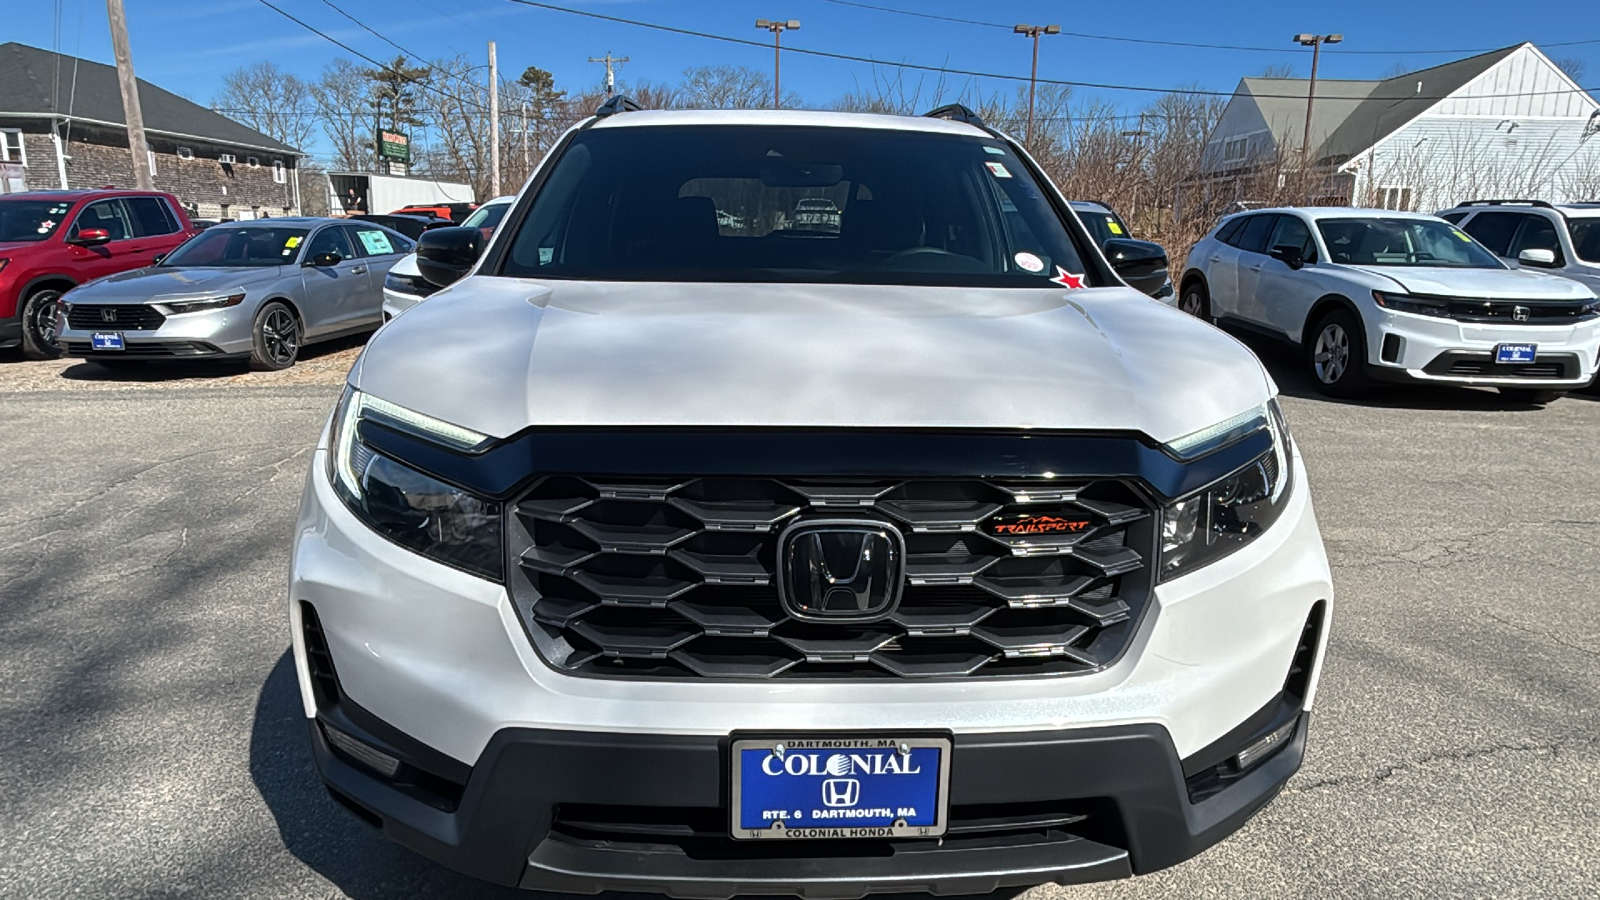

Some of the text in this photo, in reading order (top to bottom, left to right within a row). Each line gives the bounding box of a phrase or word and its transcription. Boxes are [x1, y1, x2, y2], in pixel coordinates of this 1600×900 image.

[995, 521, 1089, 534] TRAILSPORT
[877, 739, 896, 748] MA
[761, 753, 921, 776] COLONIAL
[762, 810, 802, 819] RTE. 6
[811, 807, 916, 819] DARTMOUTH, MA
[785, 827, 894, 838] COLONIAL HONDA
